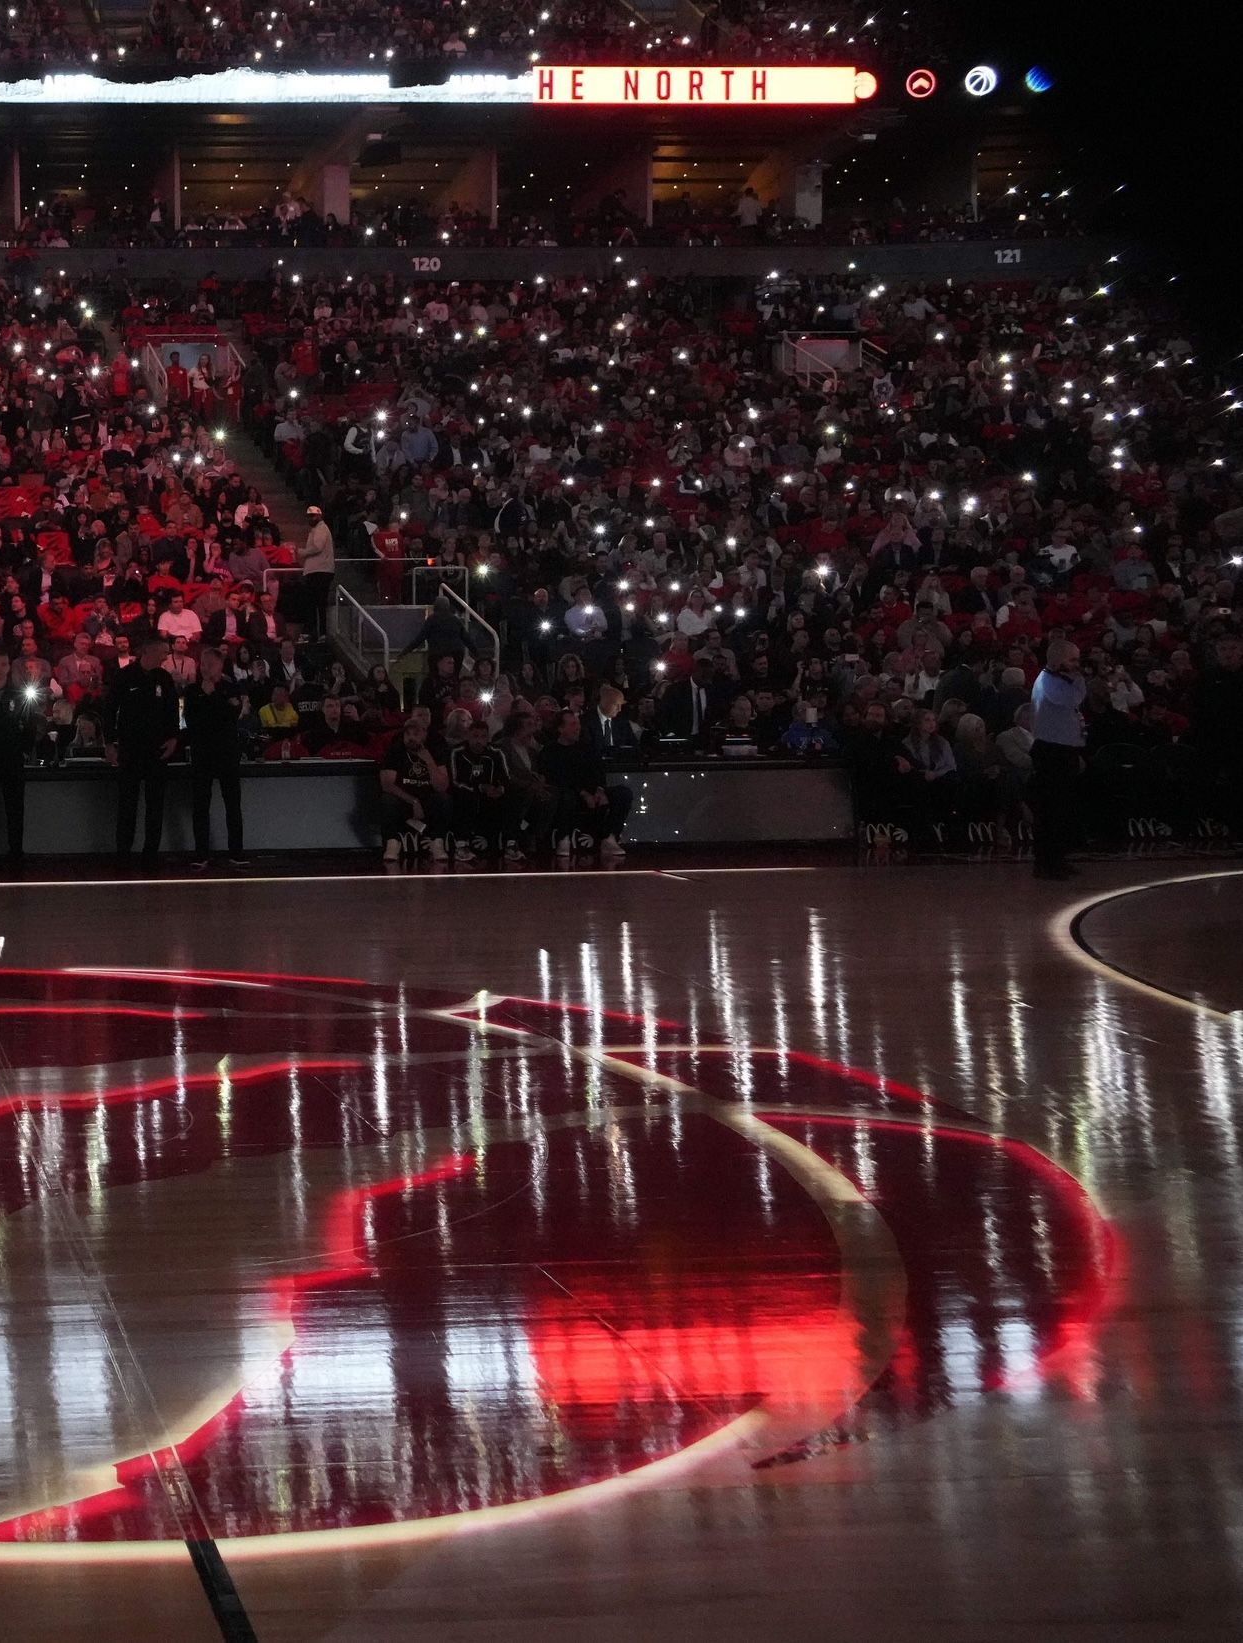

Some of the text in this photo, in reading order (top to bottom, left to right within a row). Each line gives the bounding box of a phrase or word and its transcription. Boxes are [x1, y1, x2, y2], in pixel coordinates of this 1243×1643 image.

[538, 69, 584, 100] HE
[623, 69, 767, 101] NORTH
[412, 256, 442, 273] 120
[994, 249, 1021, 264] 121
